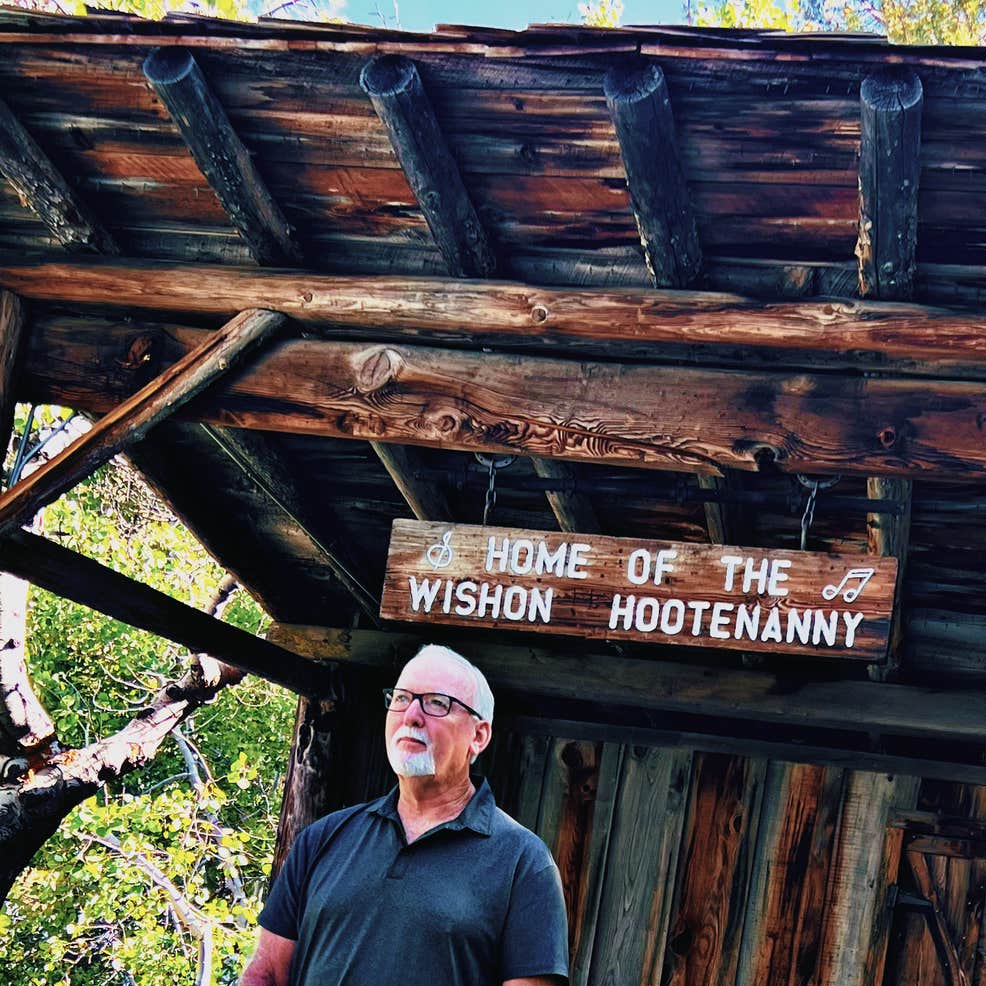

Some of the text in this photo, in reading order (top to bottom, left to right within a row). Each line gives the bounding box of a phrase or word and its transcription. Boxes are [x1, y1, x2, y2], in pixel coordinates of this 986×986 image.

[485, 536, 793, 598] HOME OF THE
[407, 575, 865, 648] WISHON HOOTENANNY
